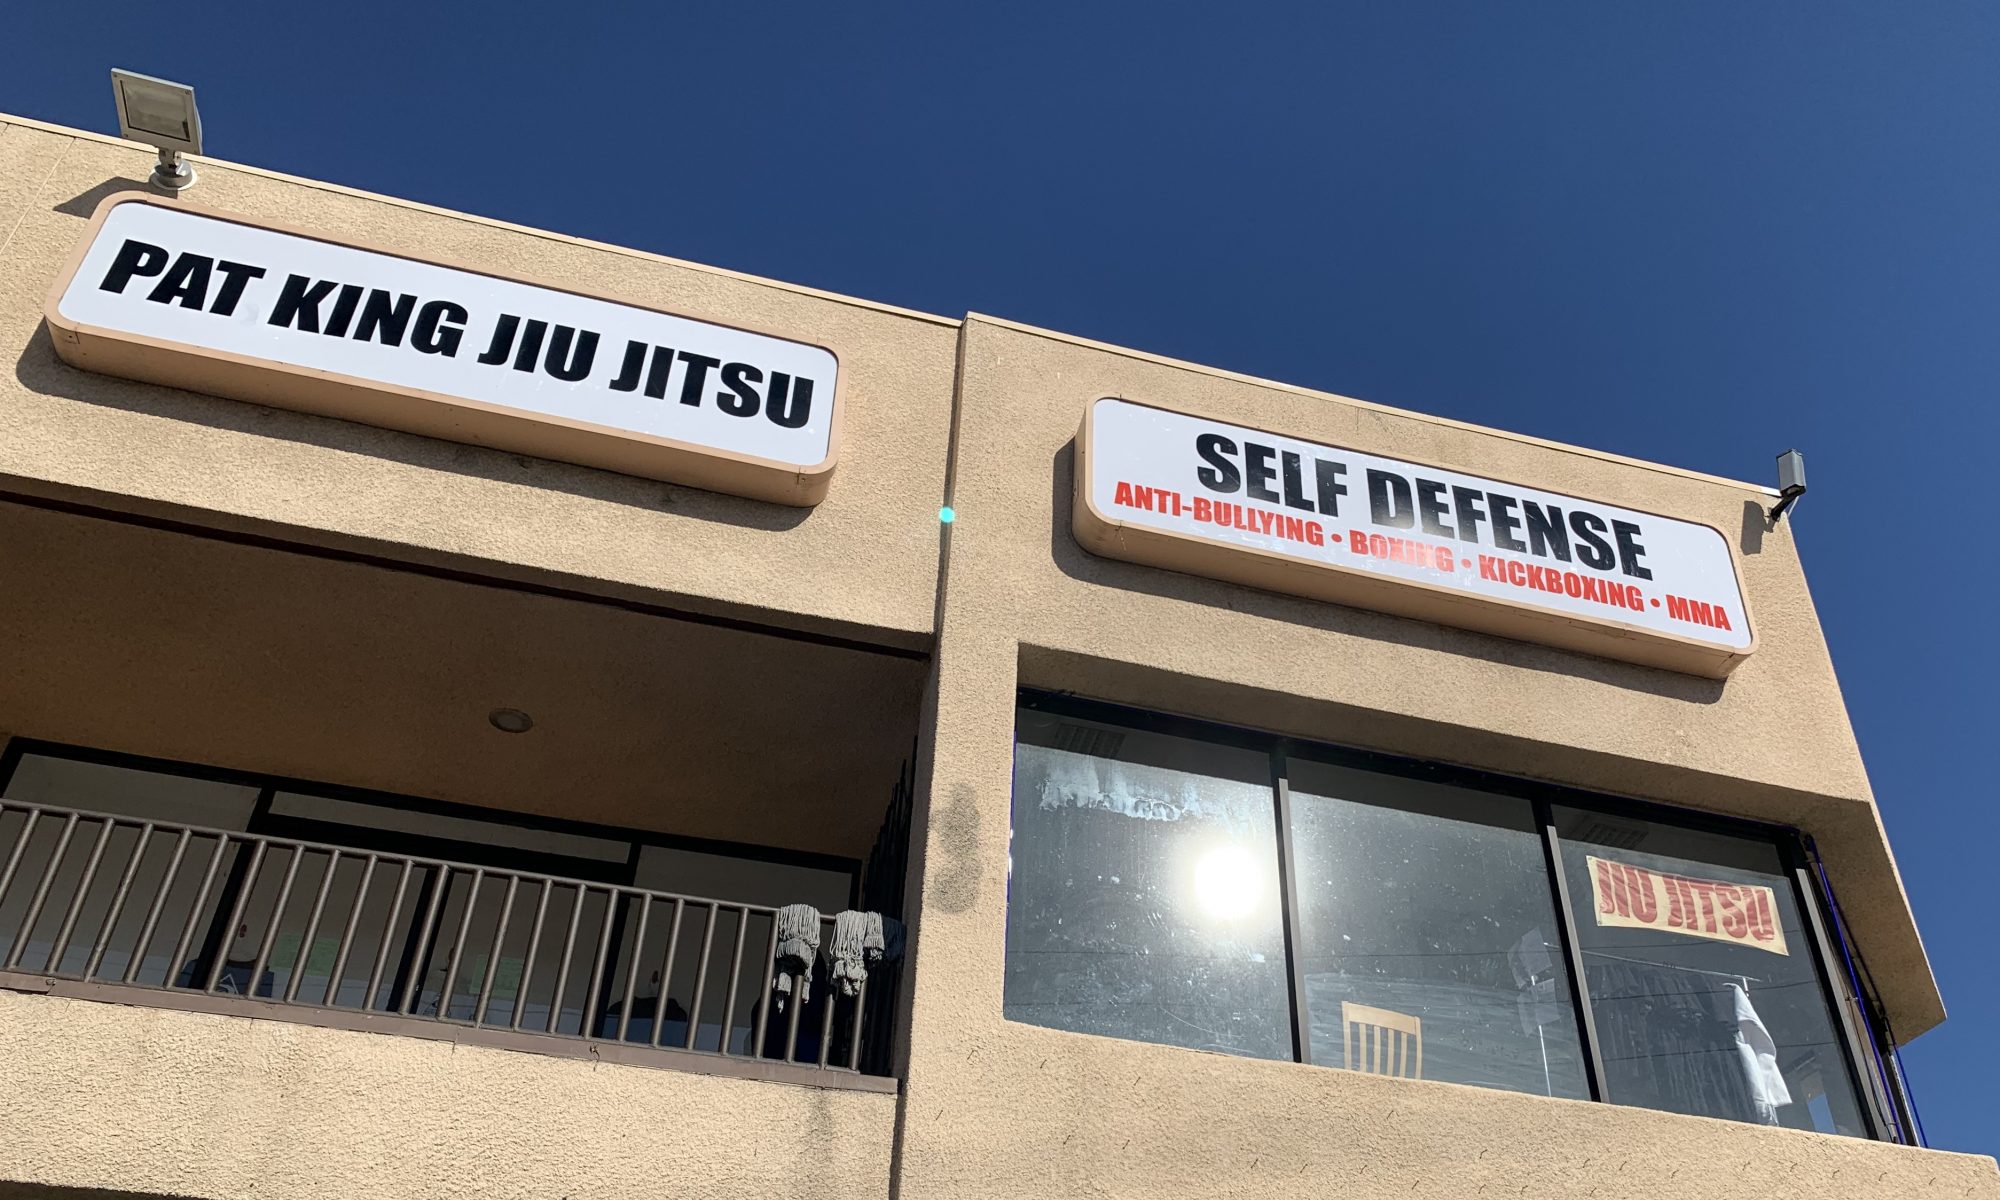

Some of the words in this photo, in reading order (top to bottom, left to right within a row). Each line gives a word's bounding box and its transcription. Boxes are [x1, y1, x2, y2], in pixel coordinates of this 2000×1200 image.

[99, 238, 267, 317] PAT
[267, 273, 469, 358] KING
[478, 313, 601, 383] JIU
[608, 340, 815, 429] JITSU
[1113, 480, 1325, 548] ANTI-BULLYING
[1348, 528, 1454, 574] BOXING
[1478, 554, 1646, 613] KICKBOXING
[1665, 593, 1733, 633] MMA
[1194, 432, 1348, 519] SELF
[1366, 467, 1654, 582] DEFENSE
[1663, 875, 1775, 941] JITSU
